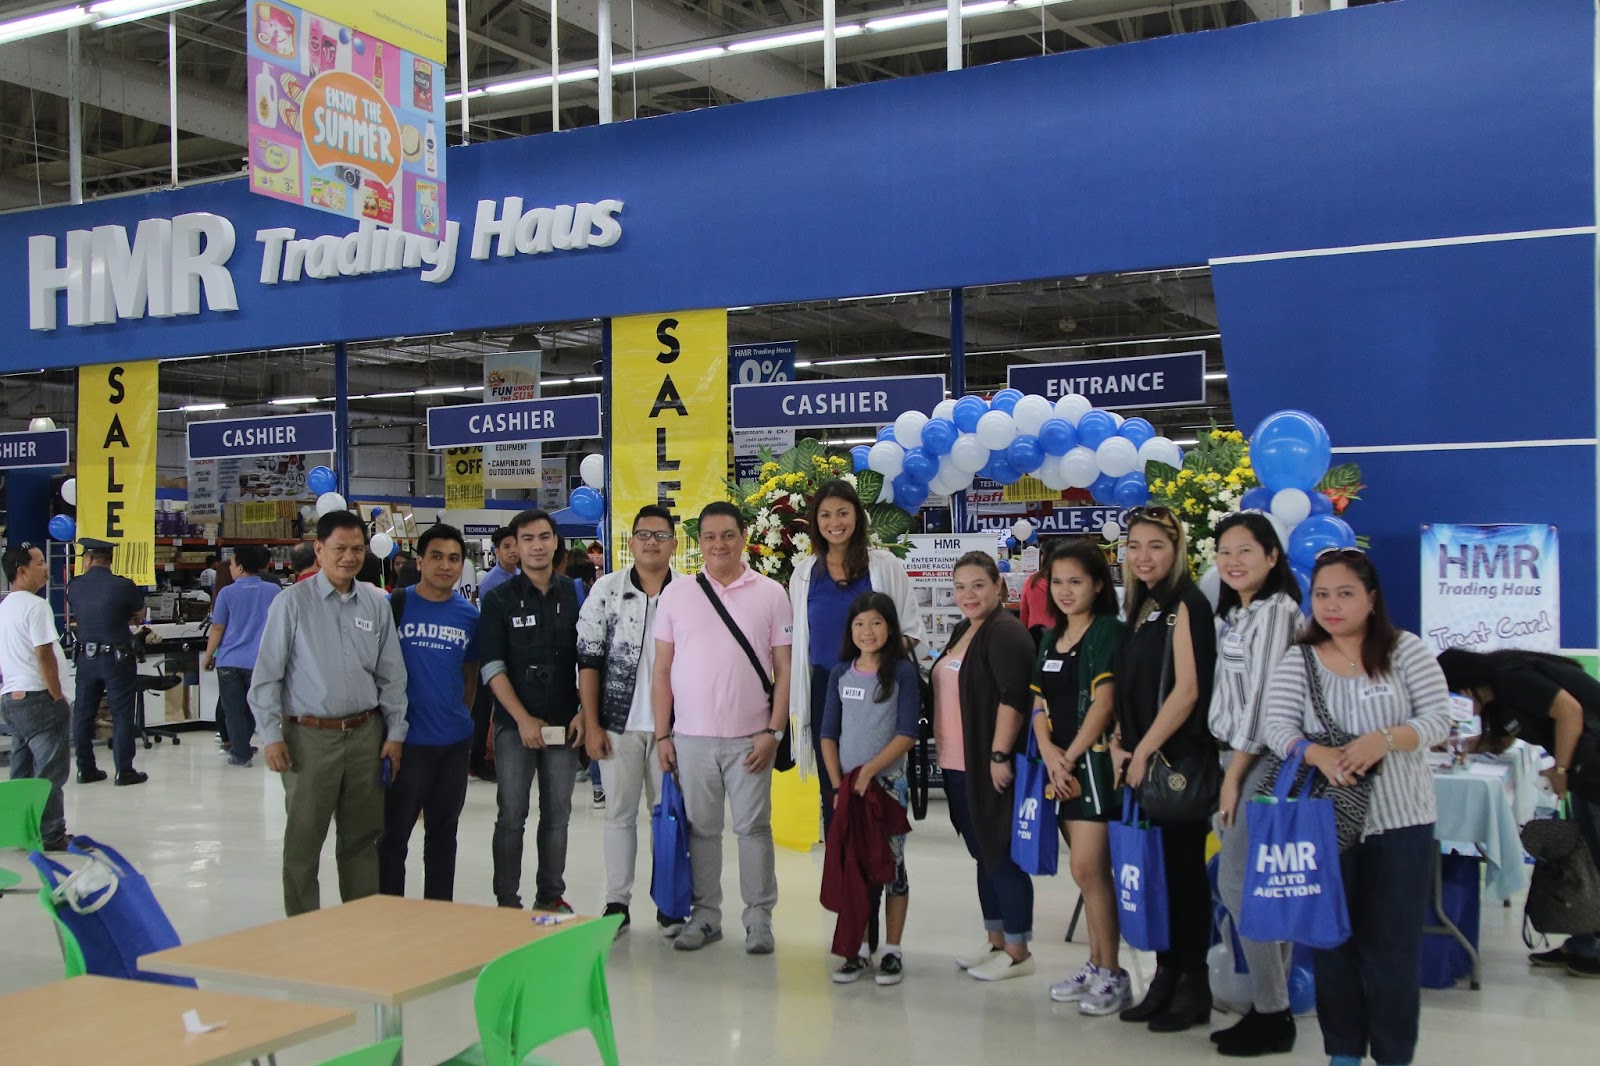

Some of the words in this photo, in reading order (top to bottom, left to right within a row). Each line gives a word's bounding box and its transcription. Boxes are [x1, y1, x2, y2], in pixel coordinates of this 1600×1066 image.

[325, 86, 357, 116] ENJOY
[361, 98, 382, 123] THE
[312, 106, 394, 165] SUMMER
[28, 211, 239, 331] HMR
[255, 220, 459, 284] Trading
[470, 196, 624, 261] Haus
[735, 348, 752, 357] HMR
[753, 348, 775, 356] Trading
[738, 359, 788, 385] 0%
[492, 386, 513, 397] FUN
[1046, 371, 1164, 397] ENTRANCE
[512, 391, 534, 401] SUN
[781, 390, 889, 416] CASHIER
[468, 409, 555, 434] CASHIER
[648, 318, 689, 526] SALE
[222, 425, 297, 447] CASHIER
[495, 443, 527, 451] EQUIPMENT
[0, 441, 37, 459] HIER
[103, 366, 130, 538] SALE
[456, 460, 483, 476] OFF
[488, 468, 516, 476] OUTDOOR
[516, 467, 535, 475] LIVING
[491, 460, 519, 468] CAMPING
[519, 459, 531, 467] AND
[934, 538, 961, 549] HMR
[1438, 543, 1540, 580] HMR
[1438, 582, 1498, 599] Trading
[1501, 582, 1542, 596] Haus
[1429, 622, 1491, 651] Treat
[1496, 610, 1552, 639] Card
[1256, 840, 1318, 874] HMR
[1253, 883, 1322, 898] AUCTION
[1267, 873, 1306, 886] AUTO
